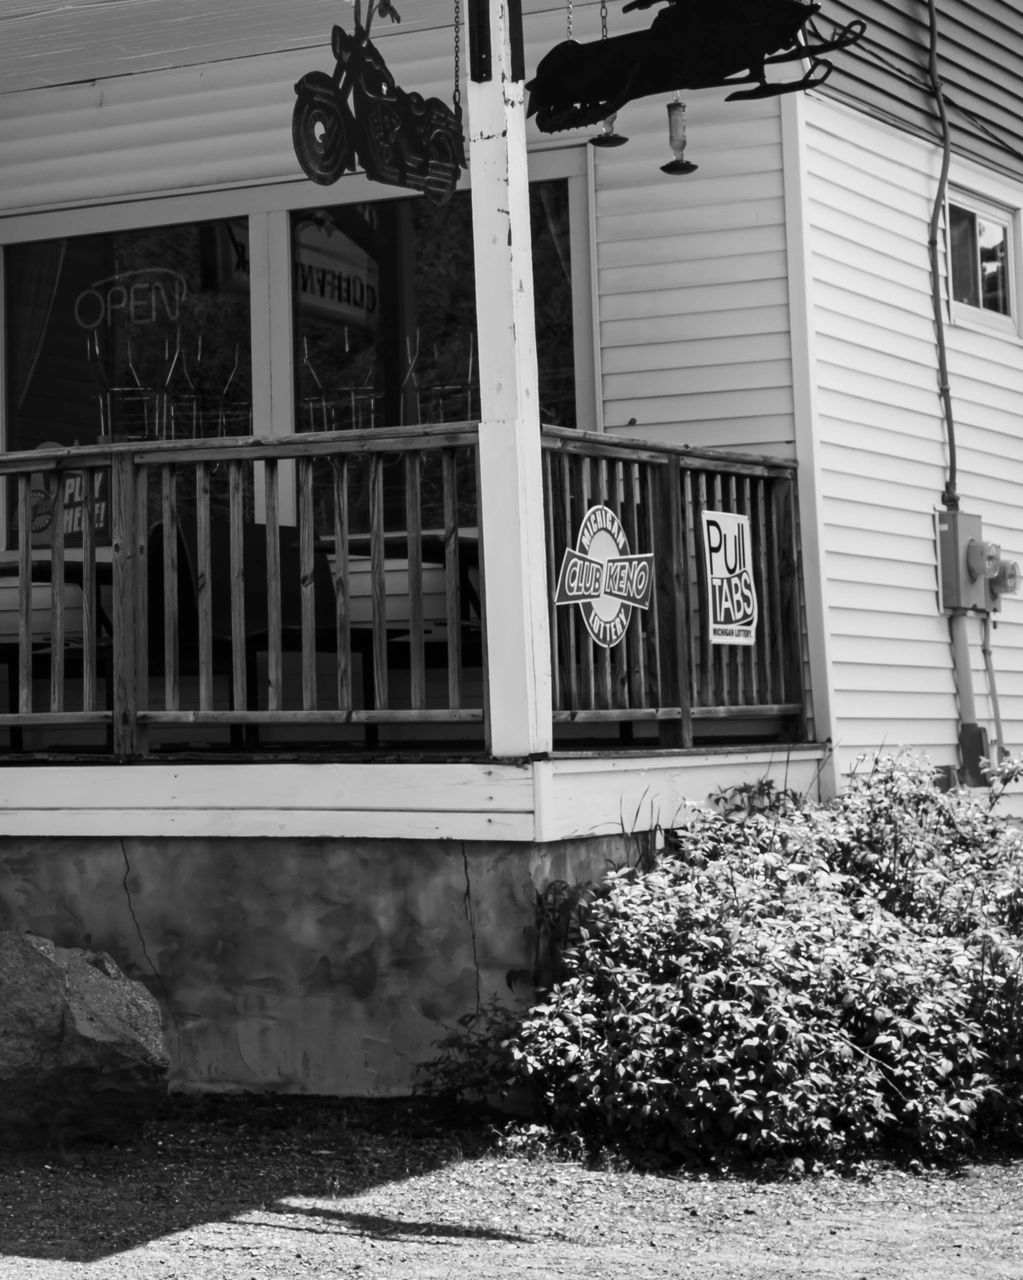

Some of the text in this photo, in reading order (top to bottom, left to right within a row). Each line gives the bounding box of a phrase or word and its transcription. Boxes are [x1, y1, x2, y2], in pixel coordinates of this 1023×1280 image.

[74, 279, 180, 330] OPEN
[64, 472, 104, 504] PLY
[581, 509, 626, 551] MICHIGAN
[565, 558, 650, 600] CLUB KENO
[712, 571, 755, 623] TABS
[588, 608, 627, 641] LOTTERY
[712, 627, 734, 637] MICHIGAN
